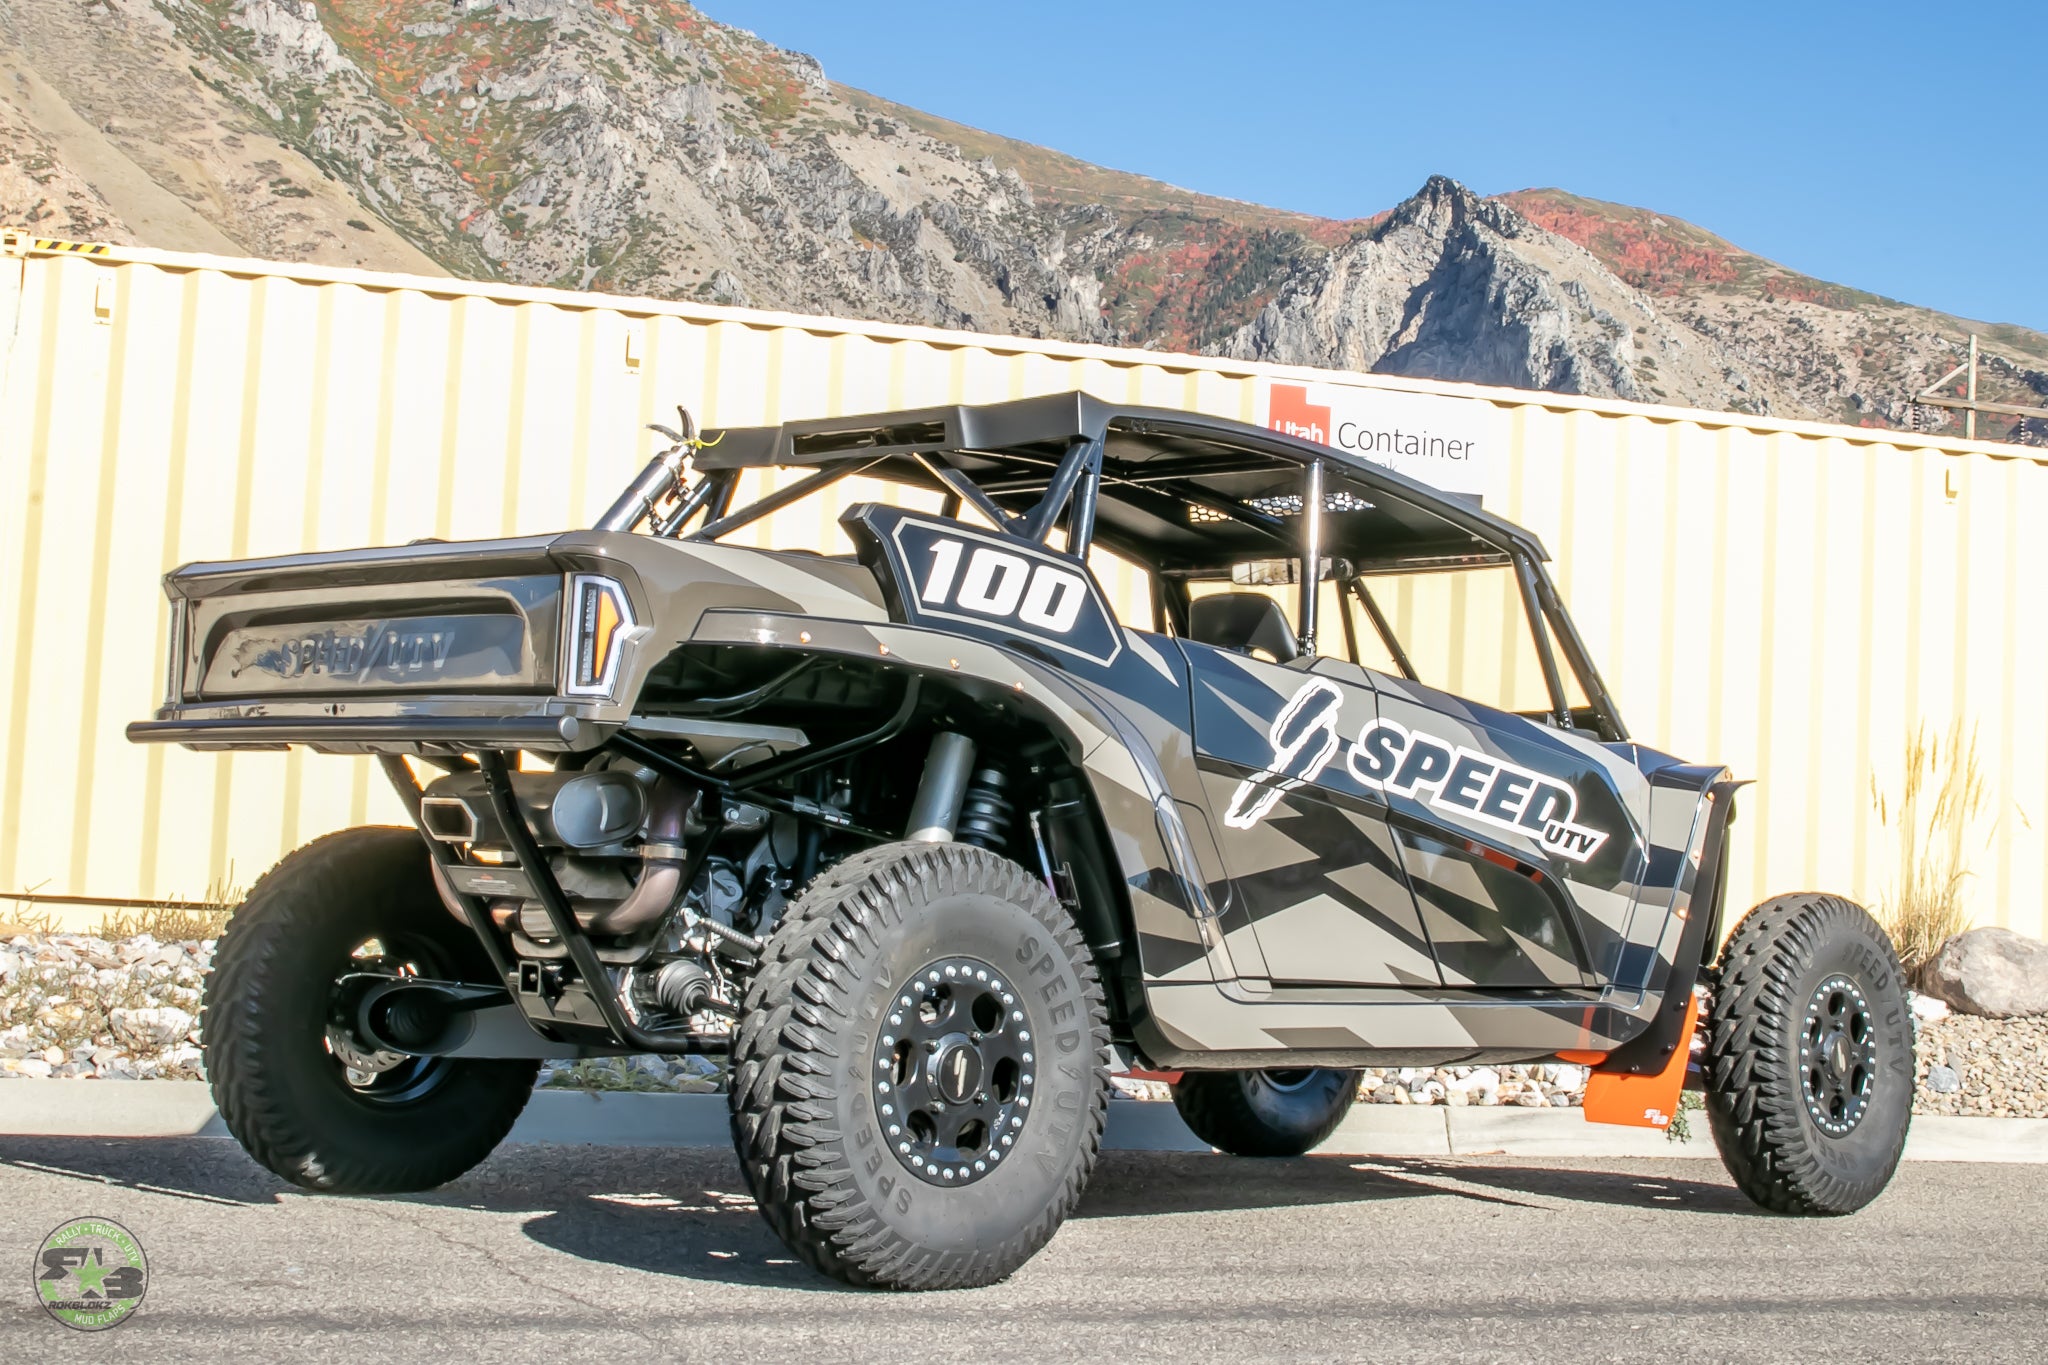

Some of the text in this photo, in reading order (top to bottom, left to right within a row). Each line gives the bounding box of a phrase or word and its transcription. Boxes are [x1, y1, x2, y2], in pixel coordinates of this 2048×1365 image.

[1338, 421, 1475, 461] Container
[922, 538, 1088, 633] 100
[1350, 724, 1578, 833] SPEED
[1544, 823, 1597, 854] UTV
[1016, 936, 1081, 1177] SPEED UTV
[1886, 1007, 1905, 1073] UTV
[849, 1091, 913, 1216] SPEED
